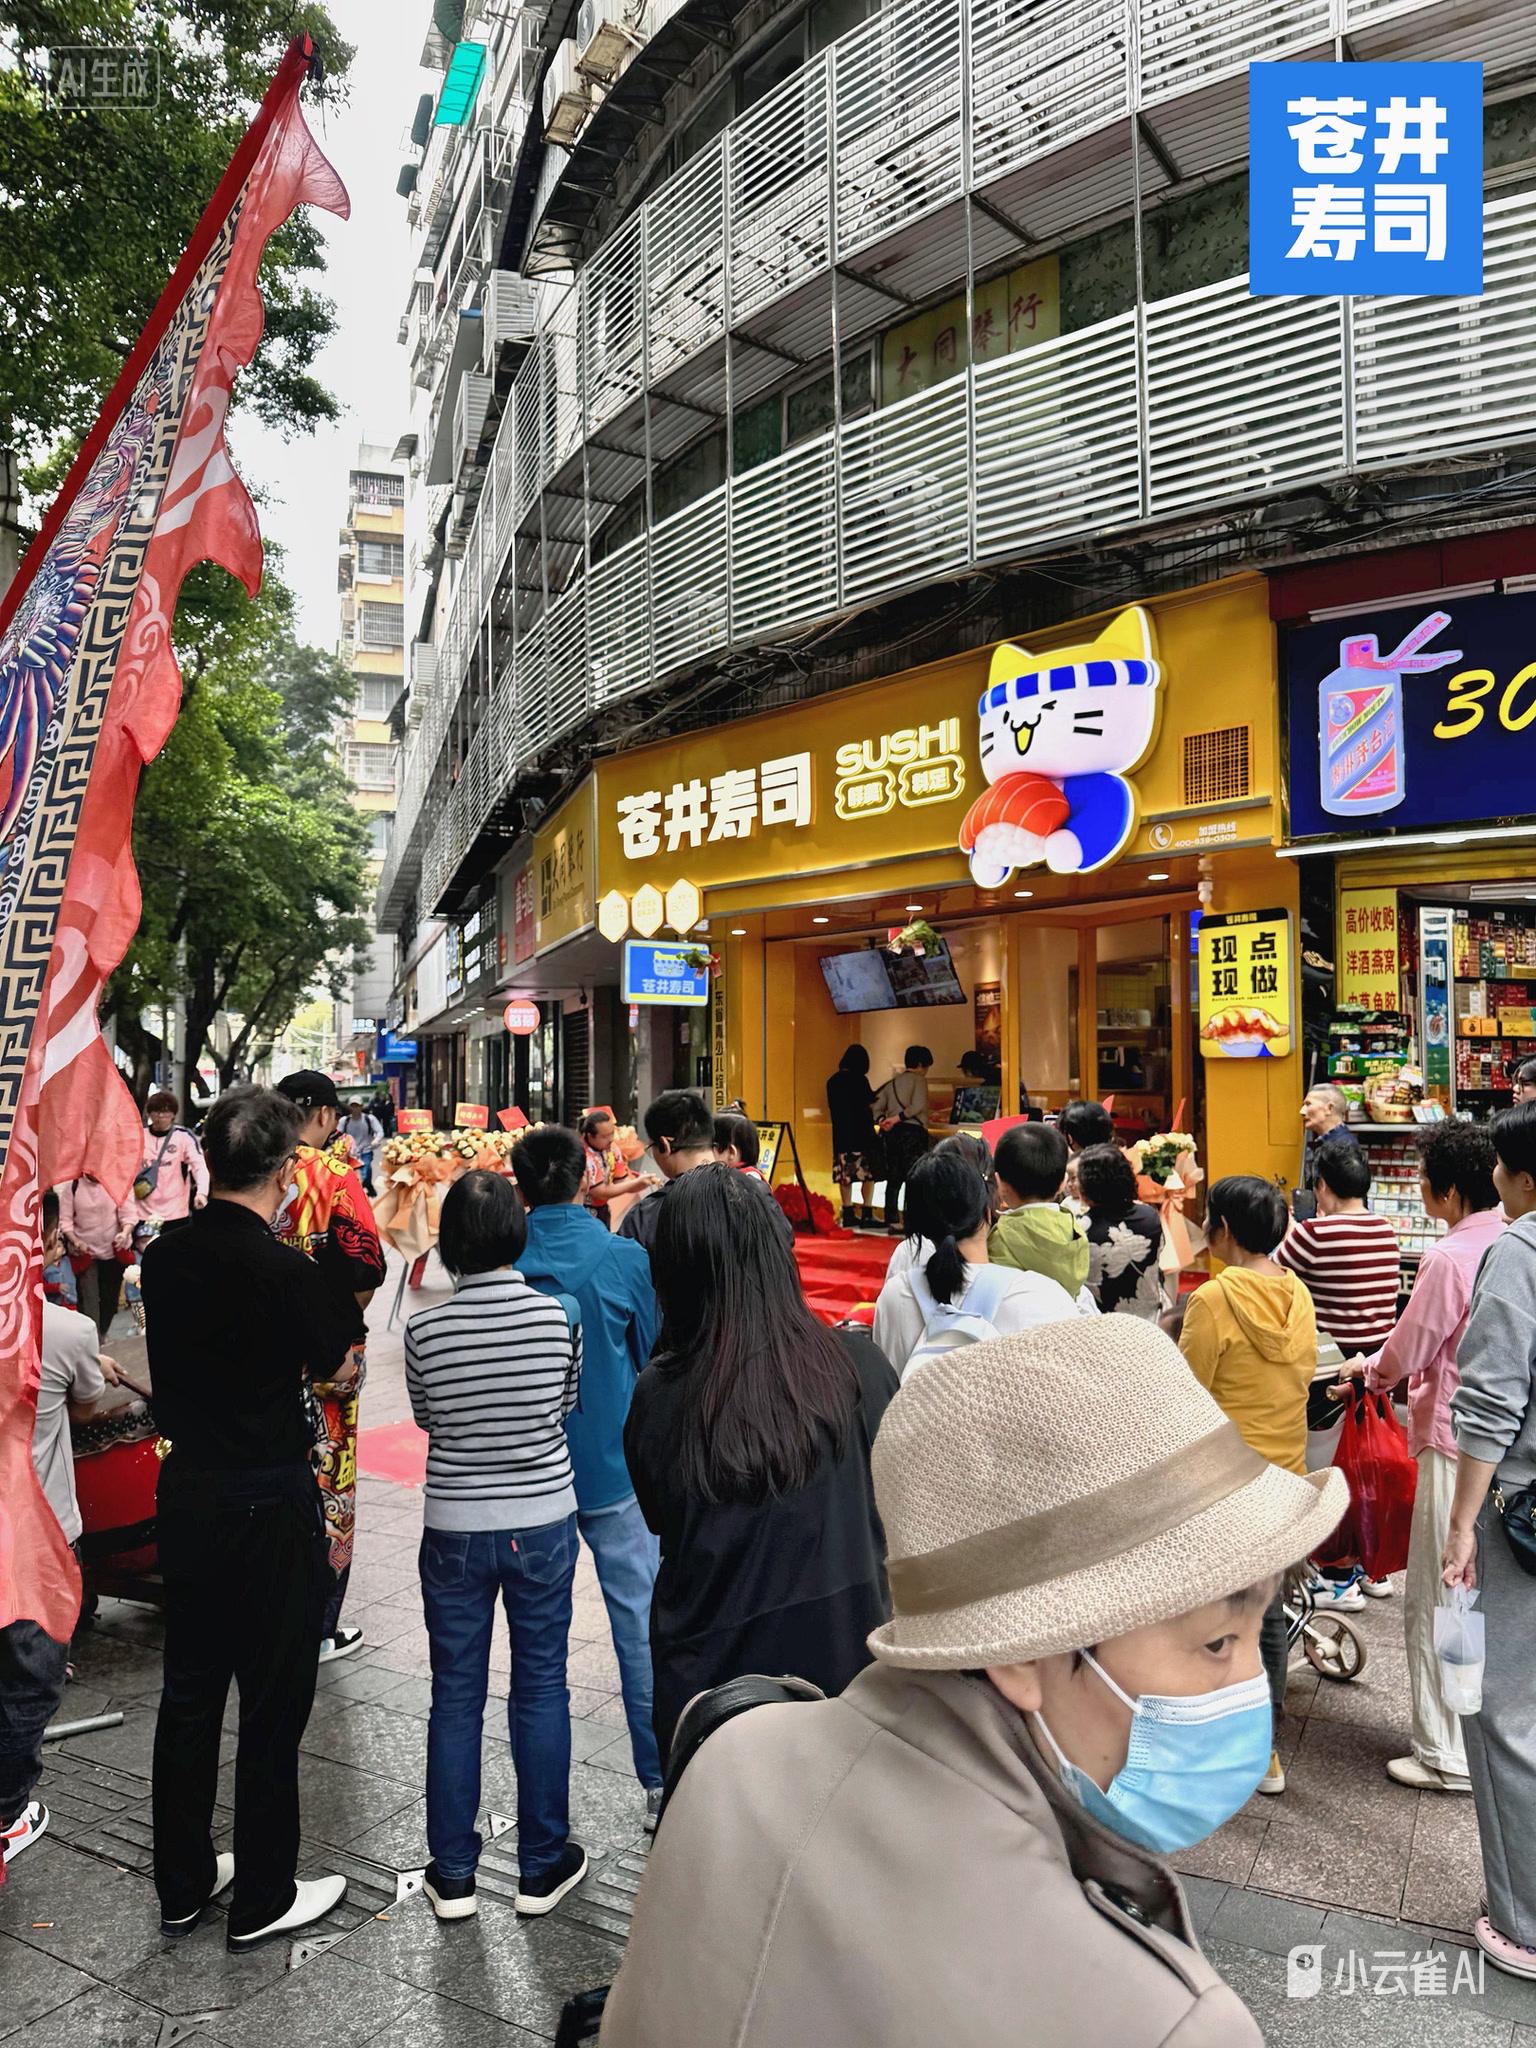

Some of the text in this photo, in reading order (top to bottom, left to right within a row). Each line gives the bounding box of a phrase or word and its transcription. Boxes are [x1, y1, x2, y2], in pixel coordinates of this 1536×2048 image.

[836, 717, 959, 776] SUSHI
[617, 752, 814, 859] 苍井寿司
[1345, 906, 1395, 934] 高价收购
[1211, 931, 1277, 964] 现点
[1347, 949, 1396, 976] 洋酒燕窝
[641, 978, 695, 995] 苍井寿司
[1212, 965, 1278, 996] 现做
